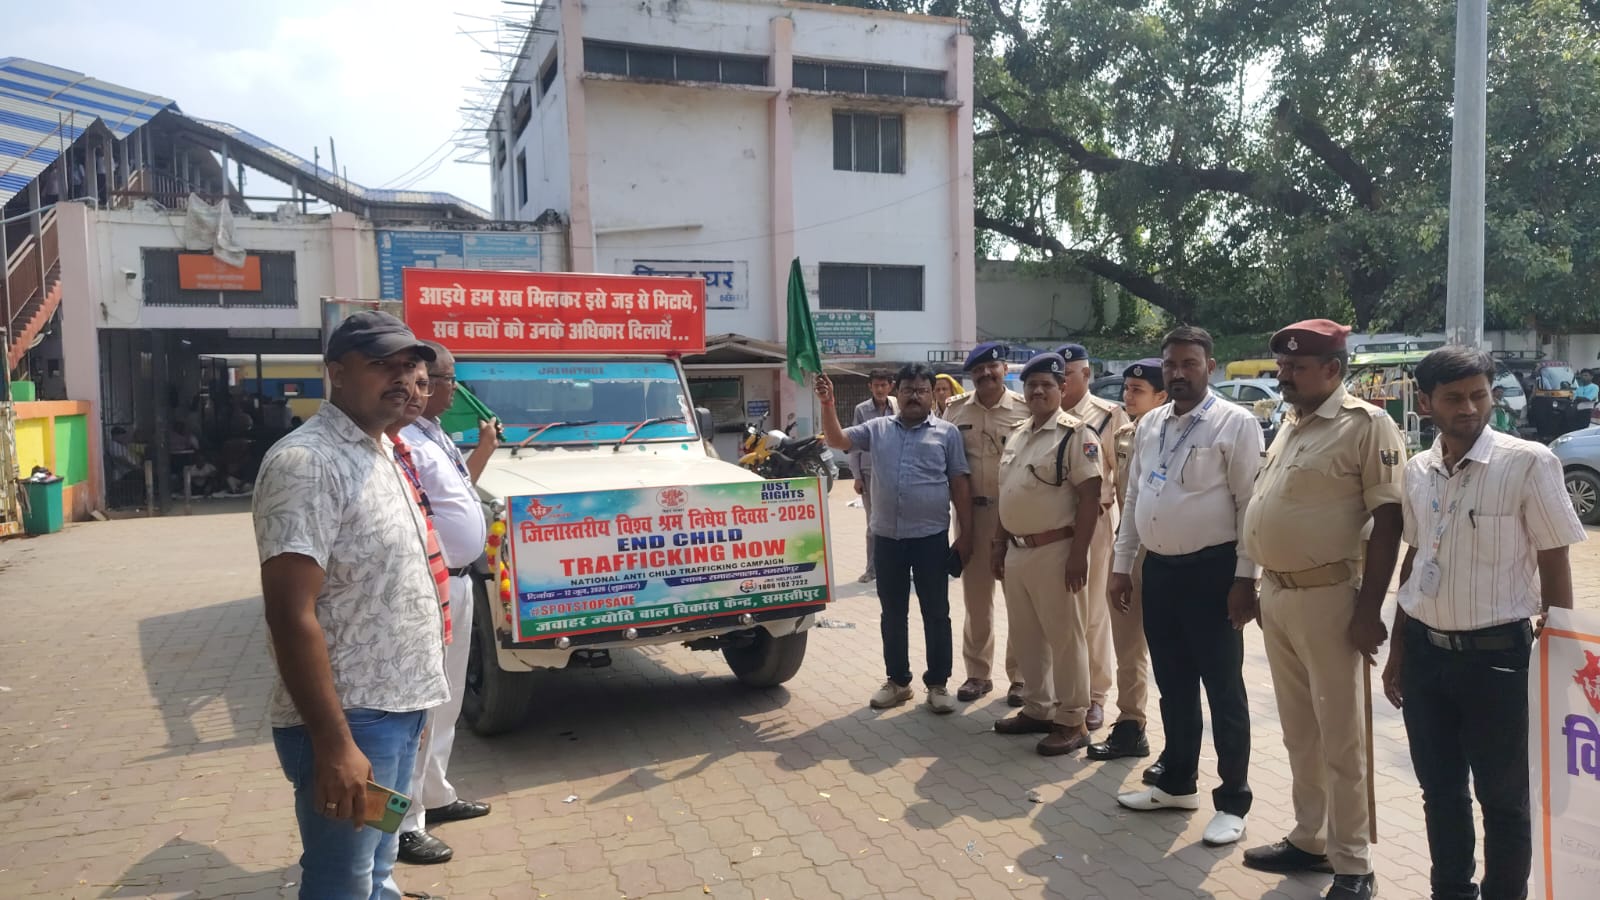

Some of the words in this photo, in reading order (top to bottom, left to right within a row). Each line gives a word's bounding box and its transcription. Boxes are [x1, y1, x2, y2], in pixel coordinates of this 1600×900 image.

[419, 283, 466, 307] आइये
[470, 288, 494, 306] हम
[498, 290, 523, 307] सब
[527, 286, 581, 308] मिलकर
[584, 288, 607, 311] इसे
[610, 291, 634, 314] जड़
[637, 289, 650, 310] से
[653, 289, 698, 314] मिटाये,
[432, 321, 459, 338] सब
[463, 317, 500, 339] बच्चों
[503, 318, 525, 339] को
[528, 318, 565, 339] उनके
[568, 319, 624, 341] अधिकार
[761, 481, 790, 491] JUST
[761, 489, 805, 500] RIGHTS
[520, 516, 610, 543] जिलास्तरीय
[615, 513, 652, 536] विश्व
[658, 514, 683, 532] श्रम
[731, 505, 769, 526] दिवस
[778, 504, 816, 522] 2026
[617, 535, 665, 552] END
[673, 528, 742, 546] CHILD
[560, 545, 725, 577] TRAFFICKING
[733, 539, 786, 559] NOW
[571, 576, 619, 586] NATIONAL
[624, 572, 646, 580] ANTI
[649, 569, 676, 578] CHILD
[679, 563, 738, 574] TRAFFICKING
[741, 558, 784, 568] CAMPAIGN
[530, 595, 635, 617] #SPOTSTOPSAVE
[536, 617, 587, 632] जवाहर
[591, 610, 635, 625] ज्योति
[639, 607, 669, 619] बाल
[673, 600, 719, 616] विकास
[761, 588, 819, 604] समस्तीपुर
